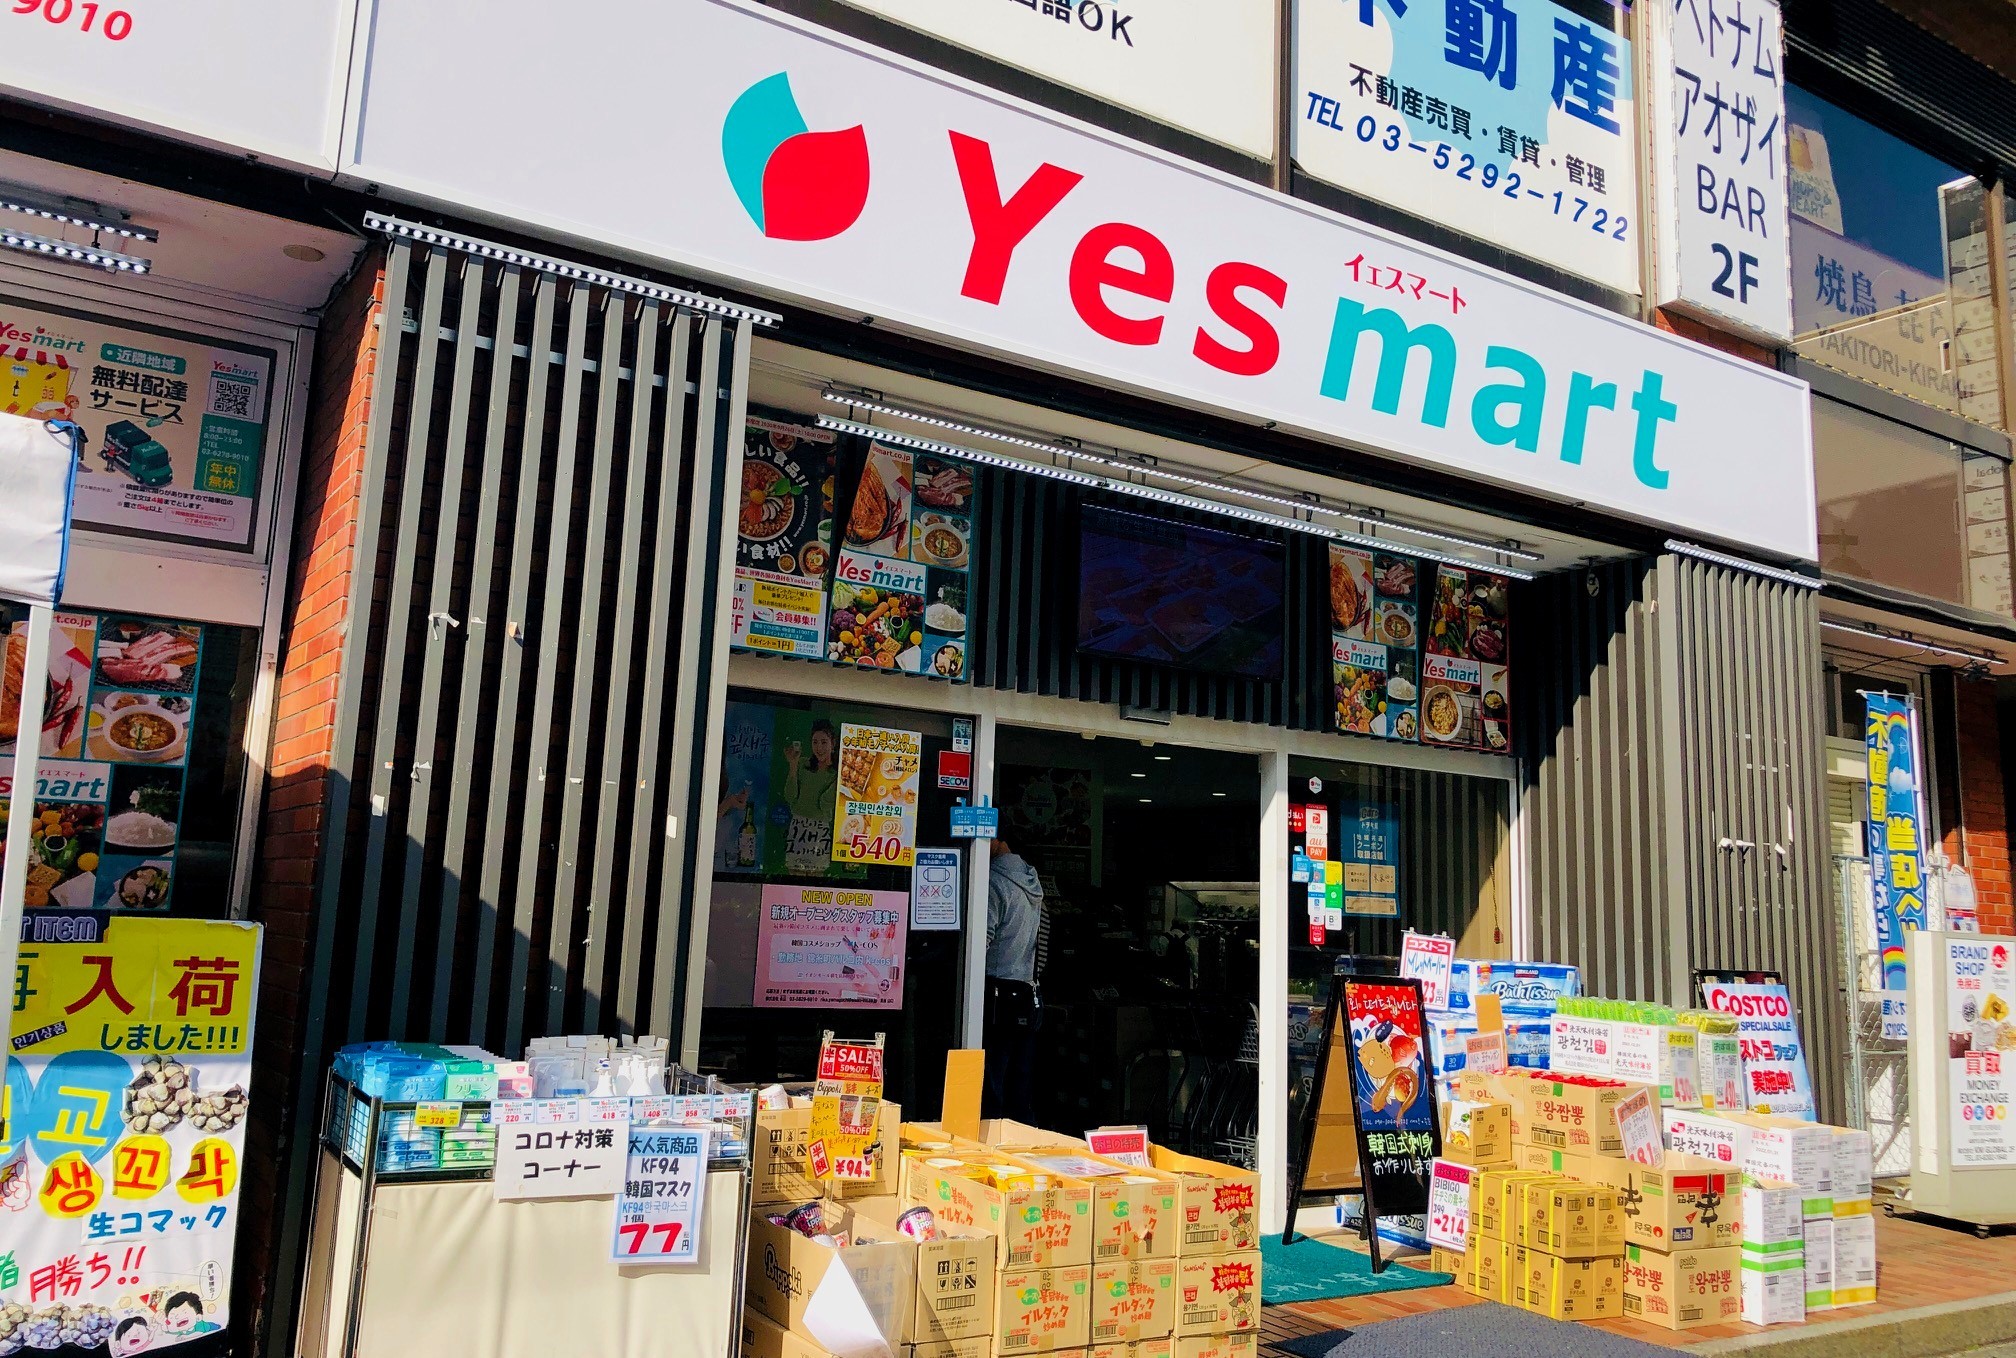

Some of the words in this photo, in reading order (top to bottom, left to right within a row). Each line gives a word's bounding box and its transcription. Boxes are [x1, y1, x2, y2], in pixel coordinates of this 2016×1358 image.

[1352, 0, 1622, 137] 動産
[1349, 62, 1608, 196] 不動産売買・賃貸・管理
[1675, 66, 1780, 181] アオザイ
[1306, 91, 1344, 132] TEL
[1356, 115, 1629, 243] 03-5292-1722
[1697, 162, 1768, 240] BAR
[1711, 242, 1760, 305] 2F
[1814, 253, 1877, 317] 焼鳥
[115, 348, 178, 372] 近隣地域
[90, 365, 189, 402] 無料配達
[89, 388, 184, 423] サービス
[208, 462, 238, 477] 年中
[207, 474, 236, 490] 無休
[775, 611, 817, 627] 会員募集!!
[894, 755, 919, 767] チャメ
[939, 776, 968, 788] SECOM
[849, 834, 901, 862] 540
[903, 852, 912, 862] 円
[1309, 836, 1324, 847] au
[1356, 841, 1384, 851] クーポン
[1310, 847, 1324, 858] PAY
[801, 889, 833, 905] NEW
[836, 891, 874, 907] OPEN
[34, 916, 98, 942] ITEM
[1408, 939, 1448, 953] コストコ
[1950, 944, 1989, 961] BRAND
[1955, 960, 1986, 977] SHOP
[1422, 980, 1437, 1004] 23
[1711, 988, 1788, 1017] COSTCO
[100, 1023, 240, 1052] しました!!!
[1557, 1035, 1595, 1053] 광천김
[823, 1047, 836, 1077] 半額
[837, 1049, 874, 1065] SALE
[1963, 1050, 2002, 1077] 買取
[839, 1064, 870, 1074] 50%OFF
[400, 1077, 441, 1094] クリーン
[454, 1081, 493, 1095] クリーン
[1750, 1069, 1796, 1096] 実施中!
[1966, 1079, 2002, 1093] MONEY
[1960, 1090, 2010, 1106] EXCHANGE
[430, 1117, 445, 1125] 328
[505, 1114, 520, 1122] 220
[552, 1113, 562, 1122] 77
[602, 1112, 616, 1120] 418
[685, 1110, 698, 1118] 858
[724, 1108, 738, 1116] 858
[1543, 1100, 1586, 1126] 왕짬뽕
[515, 1127, 615, 1151] コロナ対策
[839, 1125, 871, 1136] 50%OFF
[628, 1135, 699, 1155] 大人気商品
[1094, 1137, 1141, 1151] 本日の特売
[1367, 1131, 1434, 1158] 韓国式刺身
[1671, 1136, 1718, 1159] 광천김
[640, 1156, 680, 1176] KF94
[811, 1143, 829, 1174] 半額
[835, 1158, 864, 1177] ¥94
[1372, 1156, 1432, 1176] お作りします
[522, 1158, 602, 1180] コーナー
[625, 1180, 692, 1199] 韓国マスク
[1434, 1178, 1460, 1194] BIBIGO
[623, 1214, 645, 1223] 1個
[938, 1208, 974, 1227] ブルダック
[1433, 1204, 1445, 1215] 399
[87, 1204, 228, 1240] 生コマック
[1441, 1214, 1465, 1238] 214
[619, 1222, 683, 1255] 77
[681, 1239, 690, 1251] 円
[1023, 1223, 1072, 1243] ブルダック
[1695, 1269, 1733, 1295] 왕짬뽕
[1021, 1304, 1070, 1327] ブルダック
[1109, 1296, 1156, 1317] ブルダック
